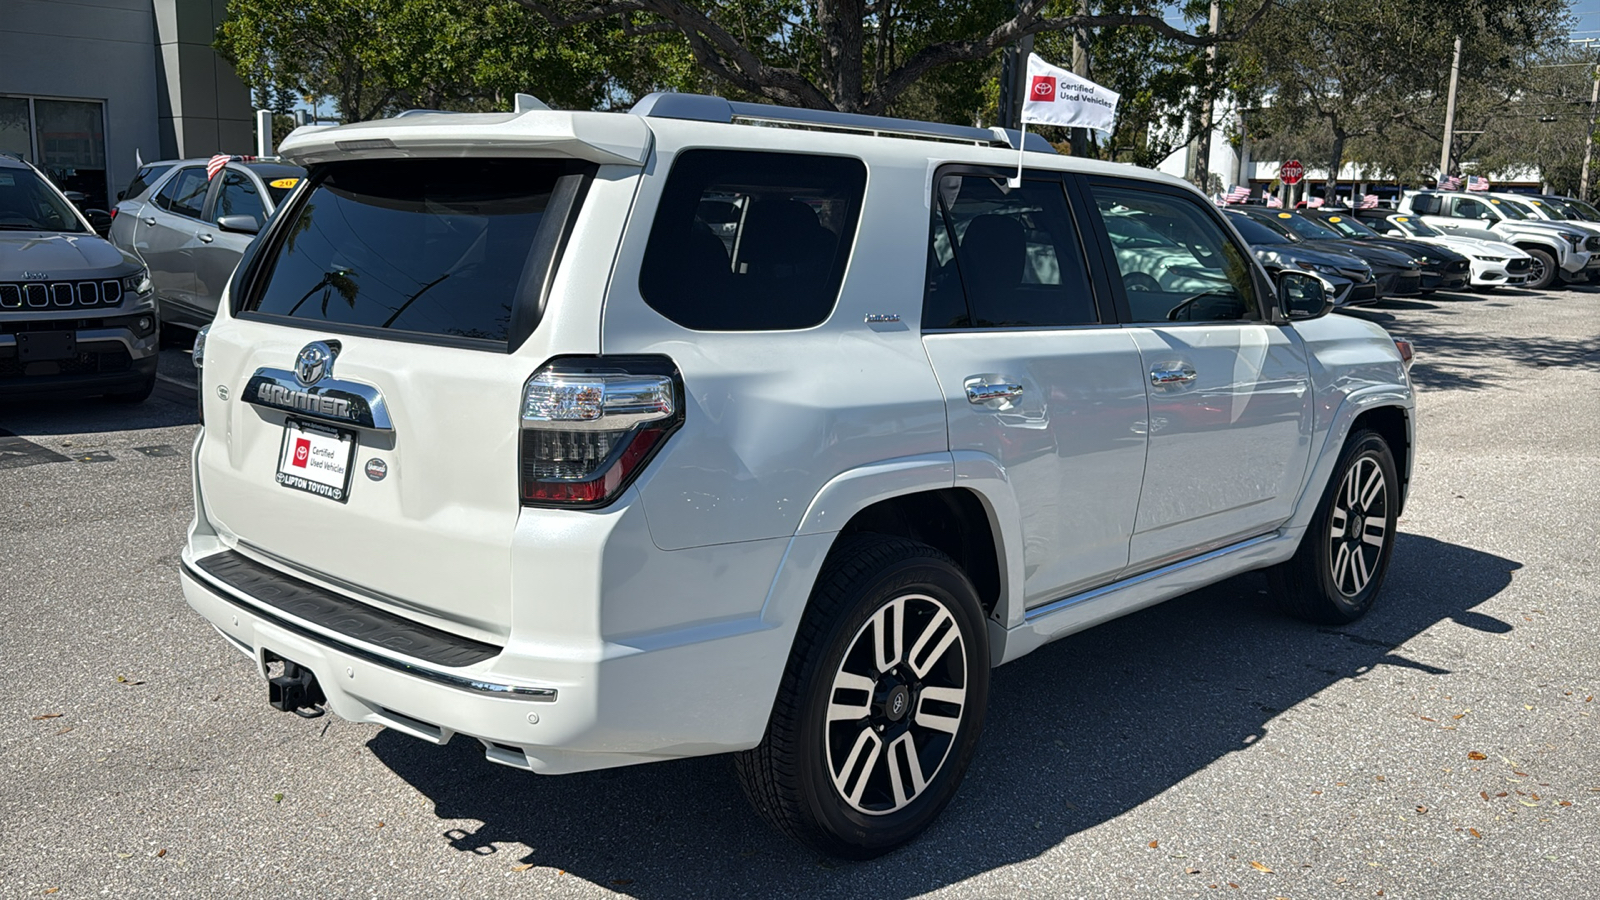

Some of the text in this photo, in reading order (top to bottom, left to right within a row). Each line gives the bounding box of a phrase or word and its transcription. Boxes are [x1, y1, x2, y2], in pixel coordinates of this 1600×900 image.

[1060, 82, 1094, 94] Certified
[1060, 92, 1112, 108] Used Vehicles
[1281, 167, 1302, 177] STOP
[257, 382, 350, 417] 4RUNNER
[312, 446, 335, 460] Certified
[310, 458, 345, 475] Used Vehicles
[284, 475, 333, 497] LIPTON TOYOTA
